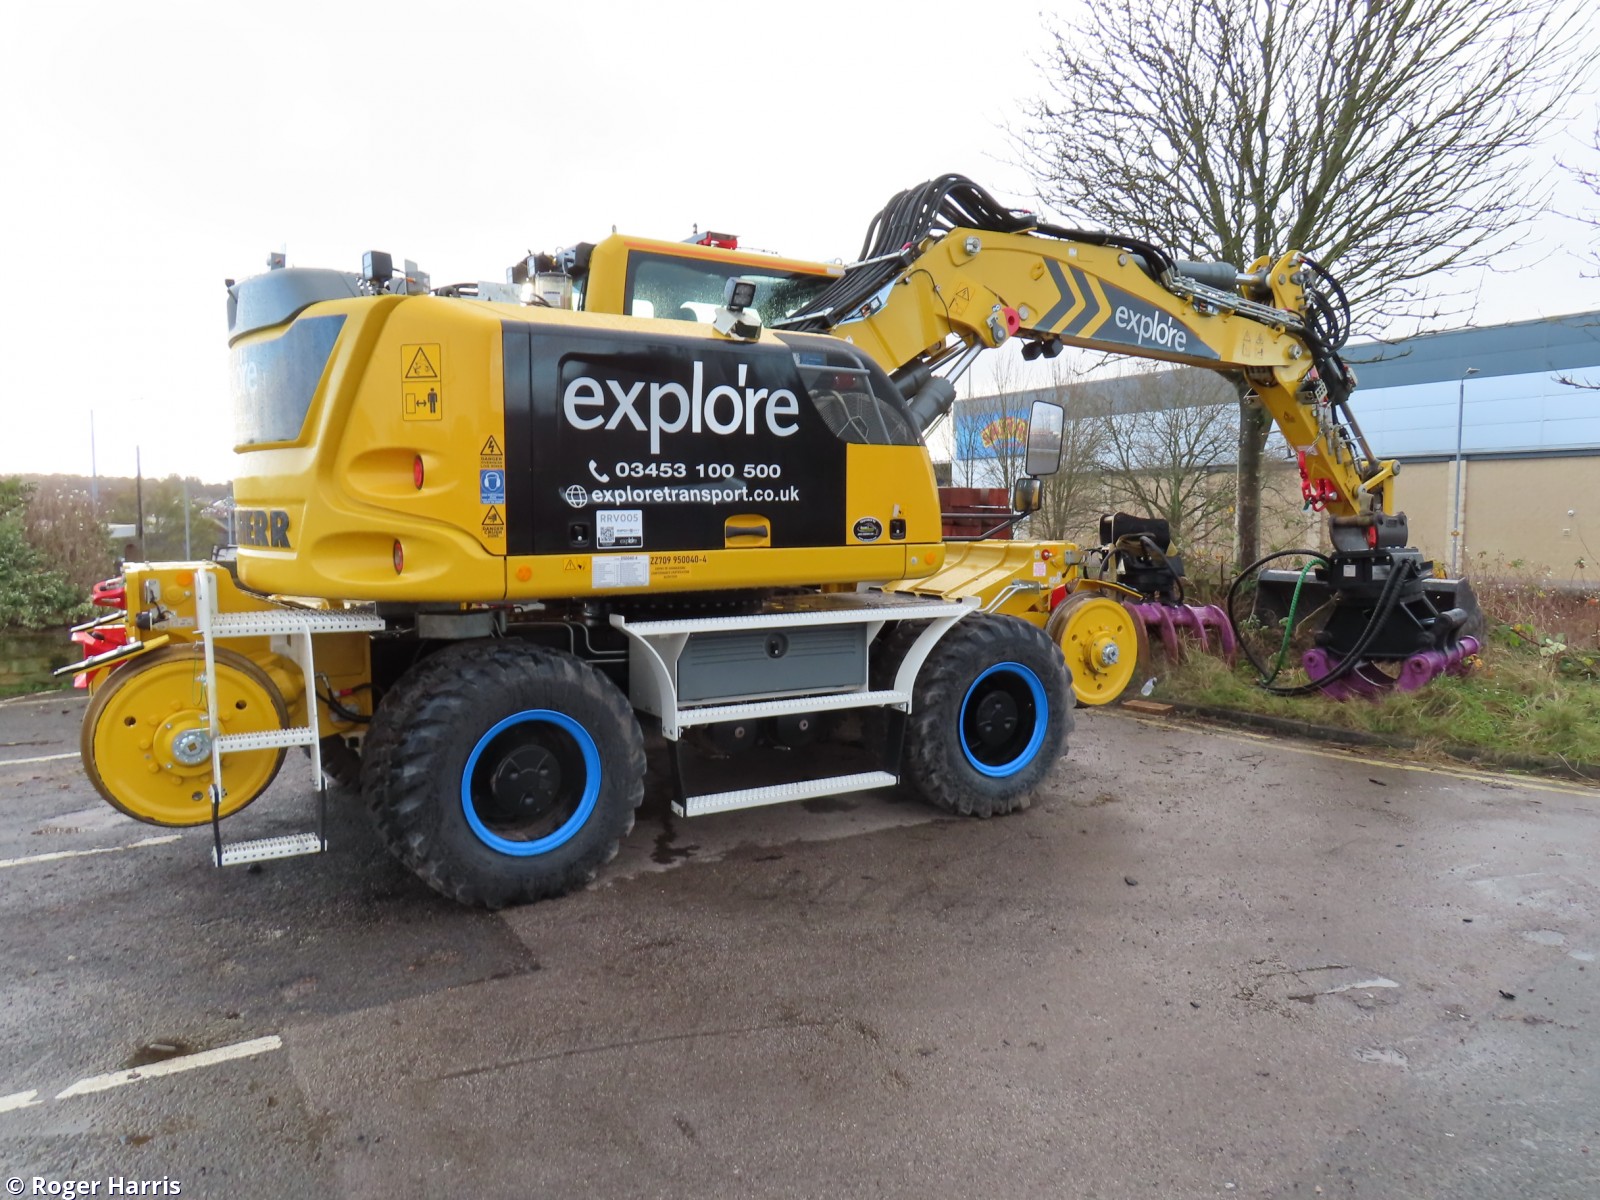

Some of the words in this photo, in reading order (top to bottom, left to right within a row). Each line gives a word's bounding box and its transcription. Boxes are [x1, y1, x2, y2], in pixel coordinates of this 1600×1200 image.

[615, 462, 687, 478] 03453
[695, 463, 735, 479] 100
[742, 463, 782, 479] 500
[591, 485, 800, 506] exploretransport.co.uk
[600, 513, 639, 523] RRV005
[650, 556, 671, 565] ZZ709
[672, 554, 707, 564] 950040-4
